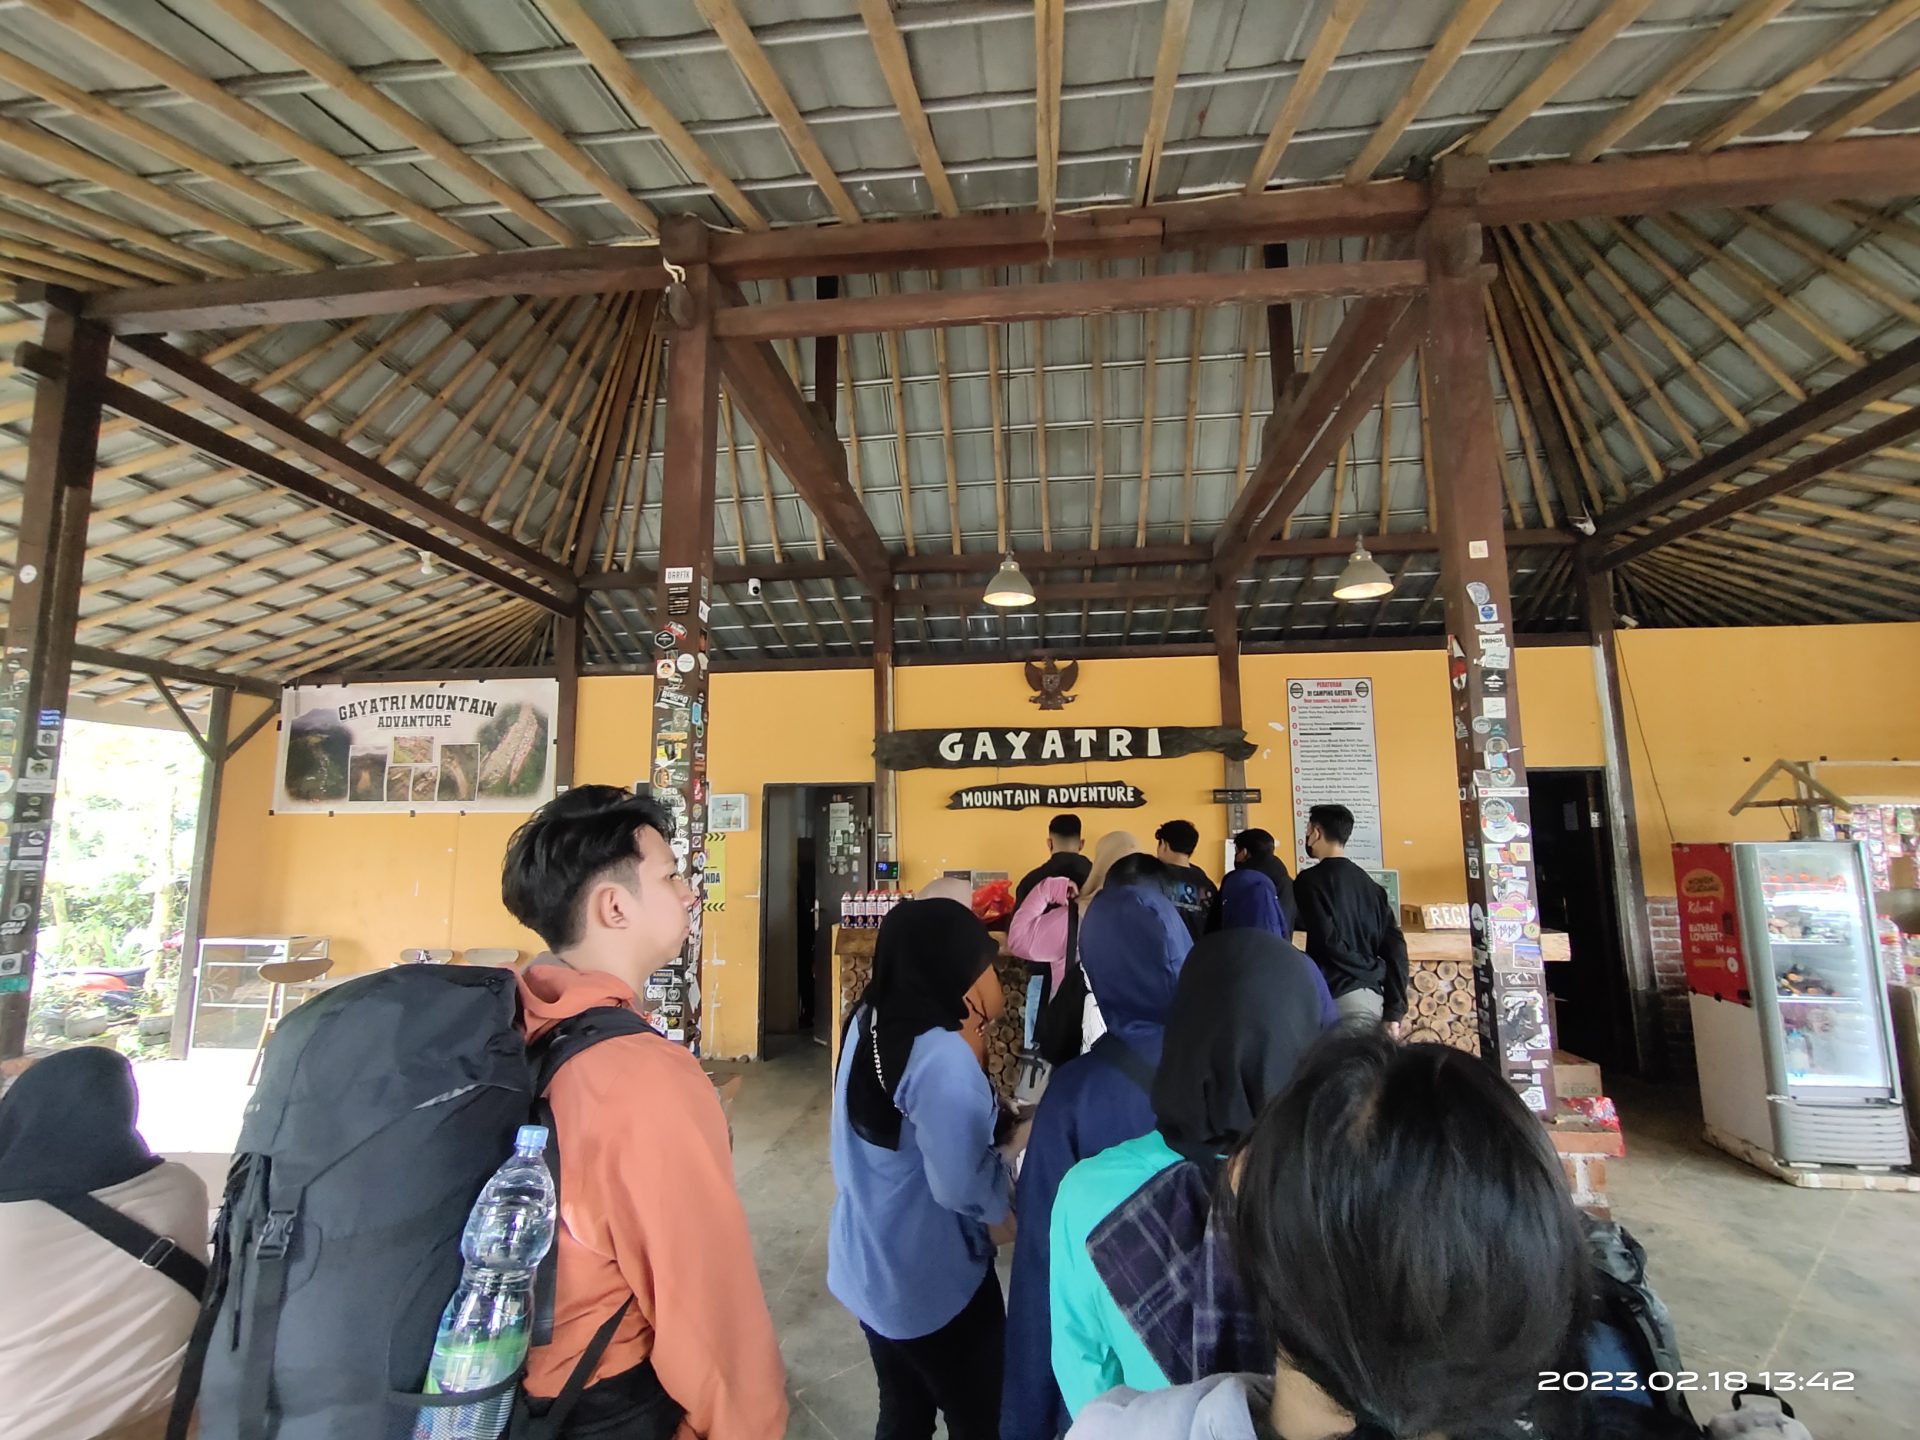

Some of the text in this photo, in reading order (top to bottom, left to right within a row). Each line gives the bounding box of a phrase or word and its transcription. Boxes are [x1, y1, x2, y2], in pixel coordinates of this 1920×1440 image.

[339, 694, 497, 721] GAYATRI MOUNTAIN
[377, 714, 452, 728] ADVANTURE
[939, 727, 1162, 761] GAYATRI
[961, 785, 1135, 807] MOUNTAIN ADVENTURE
